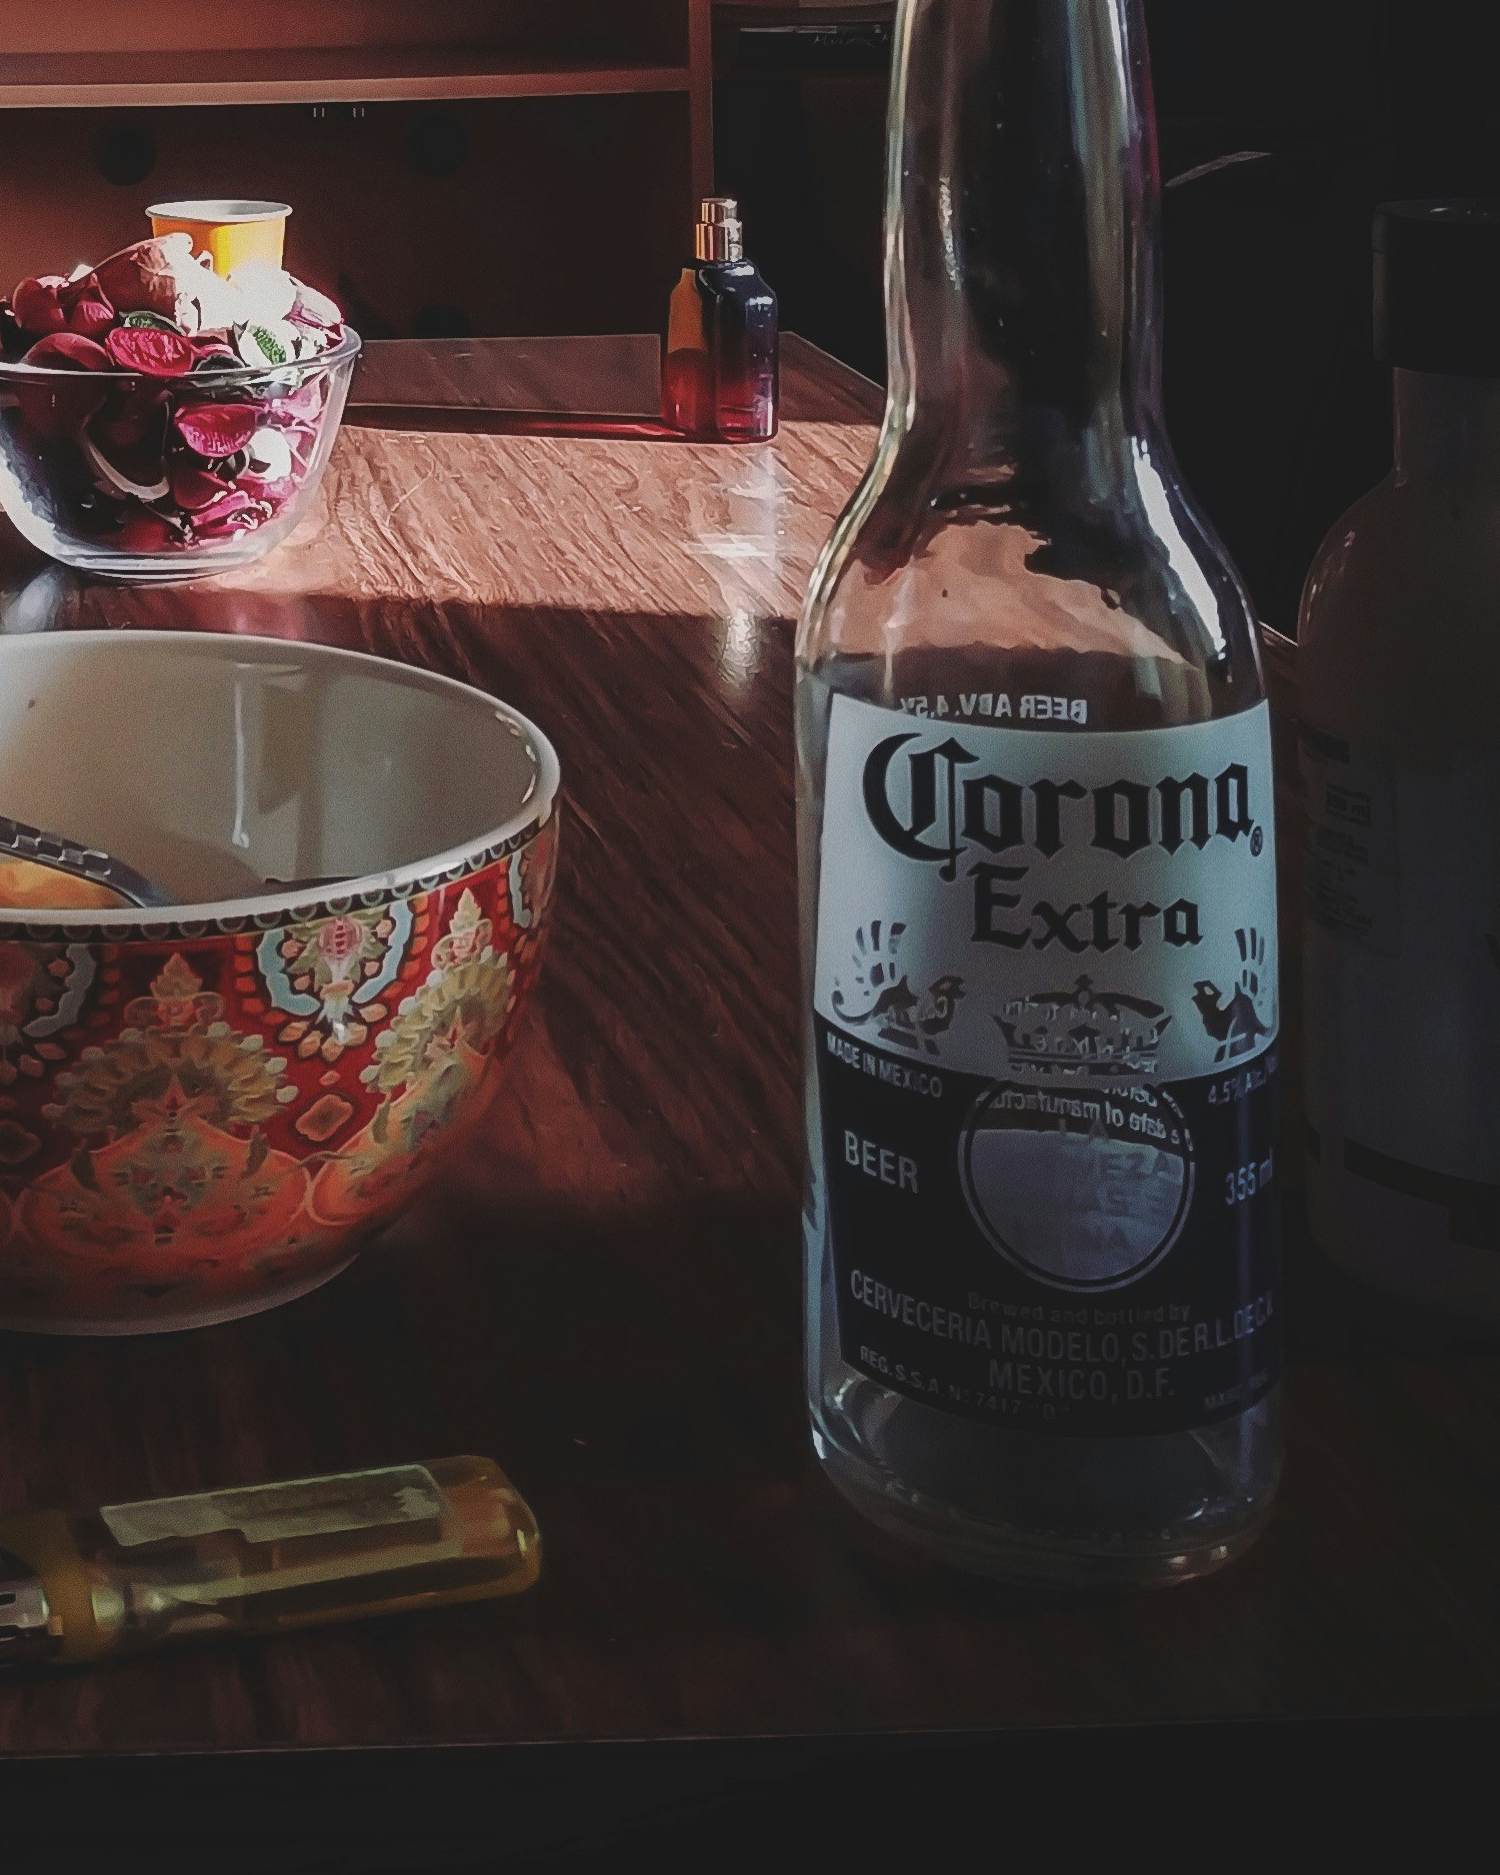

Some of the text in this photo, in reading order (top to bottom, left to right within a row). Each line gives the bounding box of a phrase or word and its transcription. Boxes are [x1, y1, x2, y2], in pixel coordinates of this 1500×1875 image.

[862, 732, 1253, 882] Corona
[966, 862, 1204, 952] Extra
[826, 1031, 944, 1098] MADE IN MEXICO
[843, 1129, 920, 1195] BEER
[1225, 1161, 1257, 1206] 355
[849, 1269, 992, 1350] CERVECERIA
[1000, 1325, 1128, 1368] MODELO,
[967, 1292, 1045, 1321] Brewed
[1050, 1309, 1088, 1325] and
[1168, 1305, 1191, 1323] by
[989, 1359, 1176, 1405] MEXICO, D.F.
